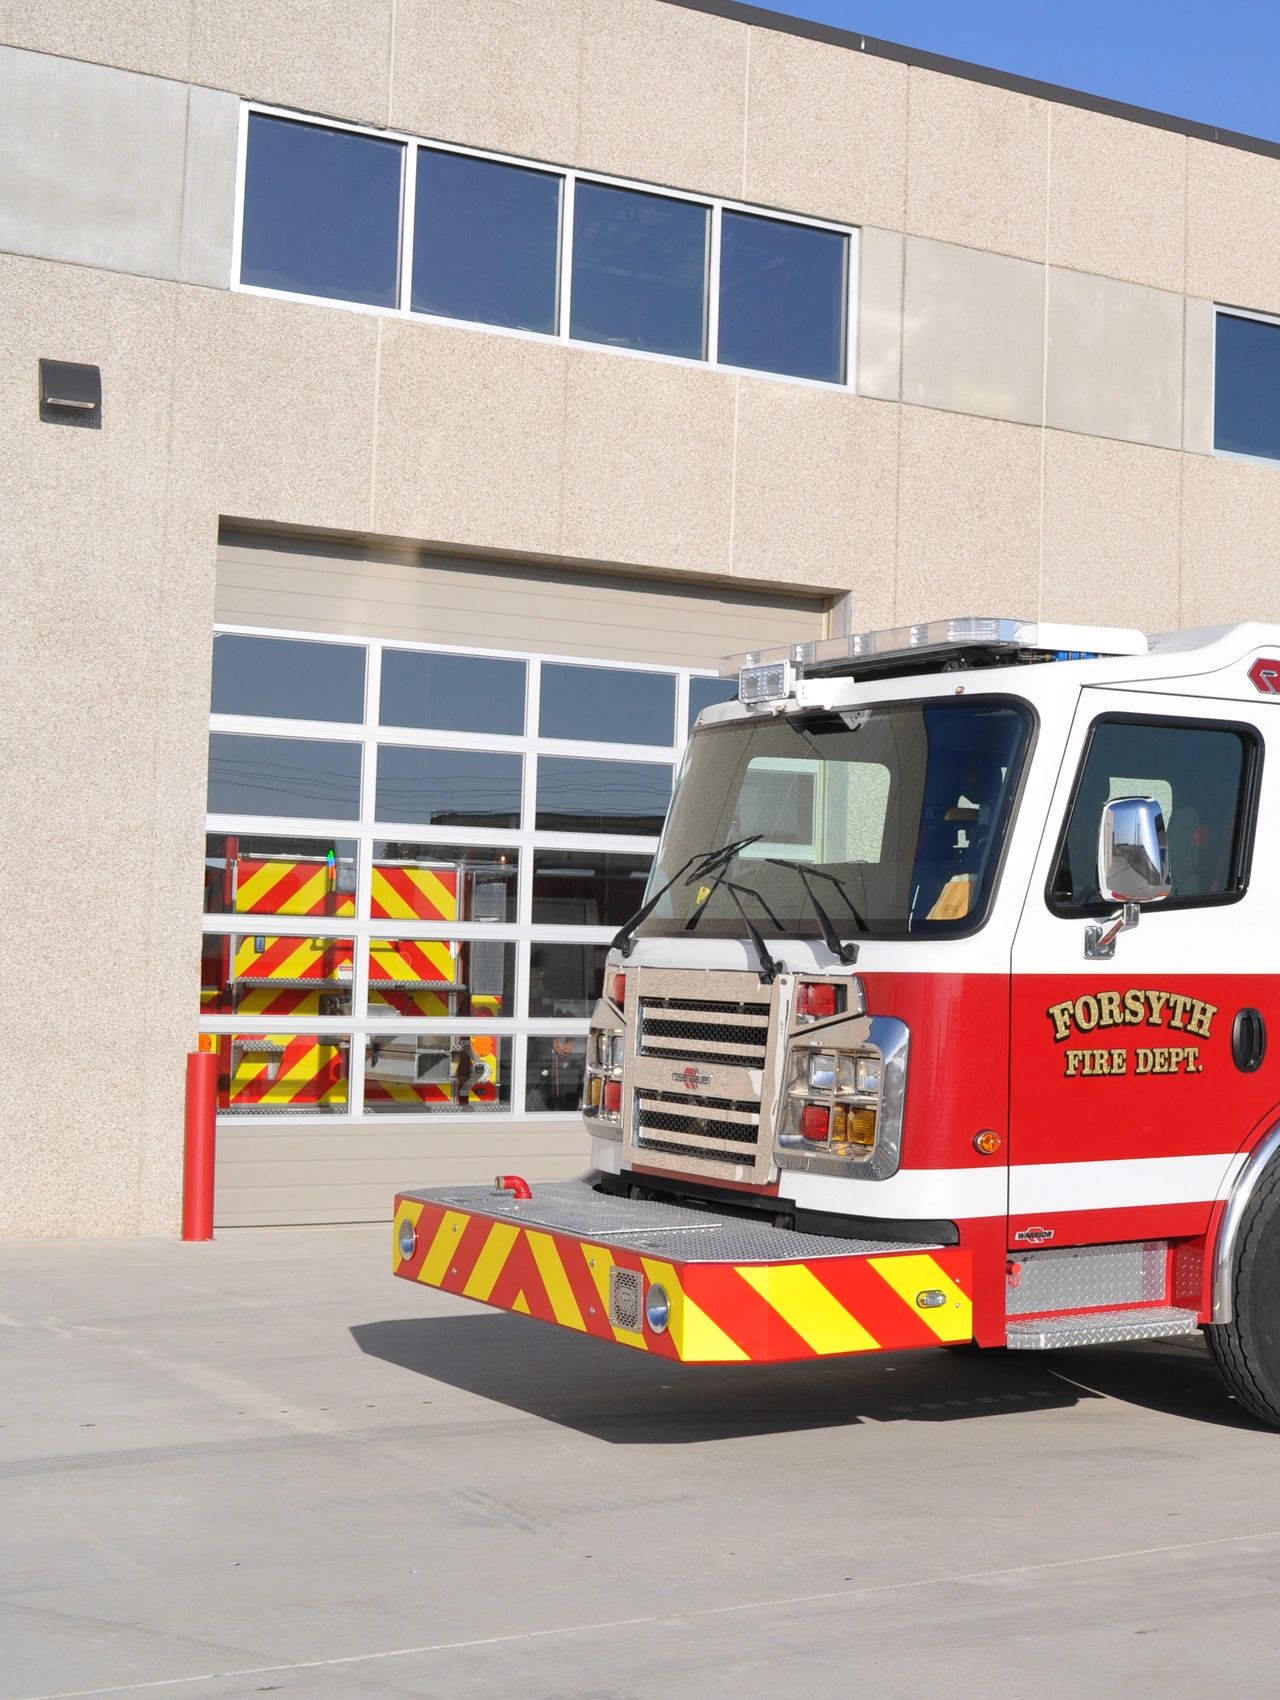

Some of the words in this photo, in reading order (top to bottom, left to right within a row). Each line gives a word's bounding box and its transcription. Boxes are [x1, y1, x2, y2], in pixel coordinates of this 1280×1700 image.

[1048, 989, 1217, 1042] FORSYTH
[1065, 1049, 1126, 1076] FIRE
[1135, 1047, 1203, 1075] DEPT.
[1017, 1230, 1053, 1239] WARRIOR
